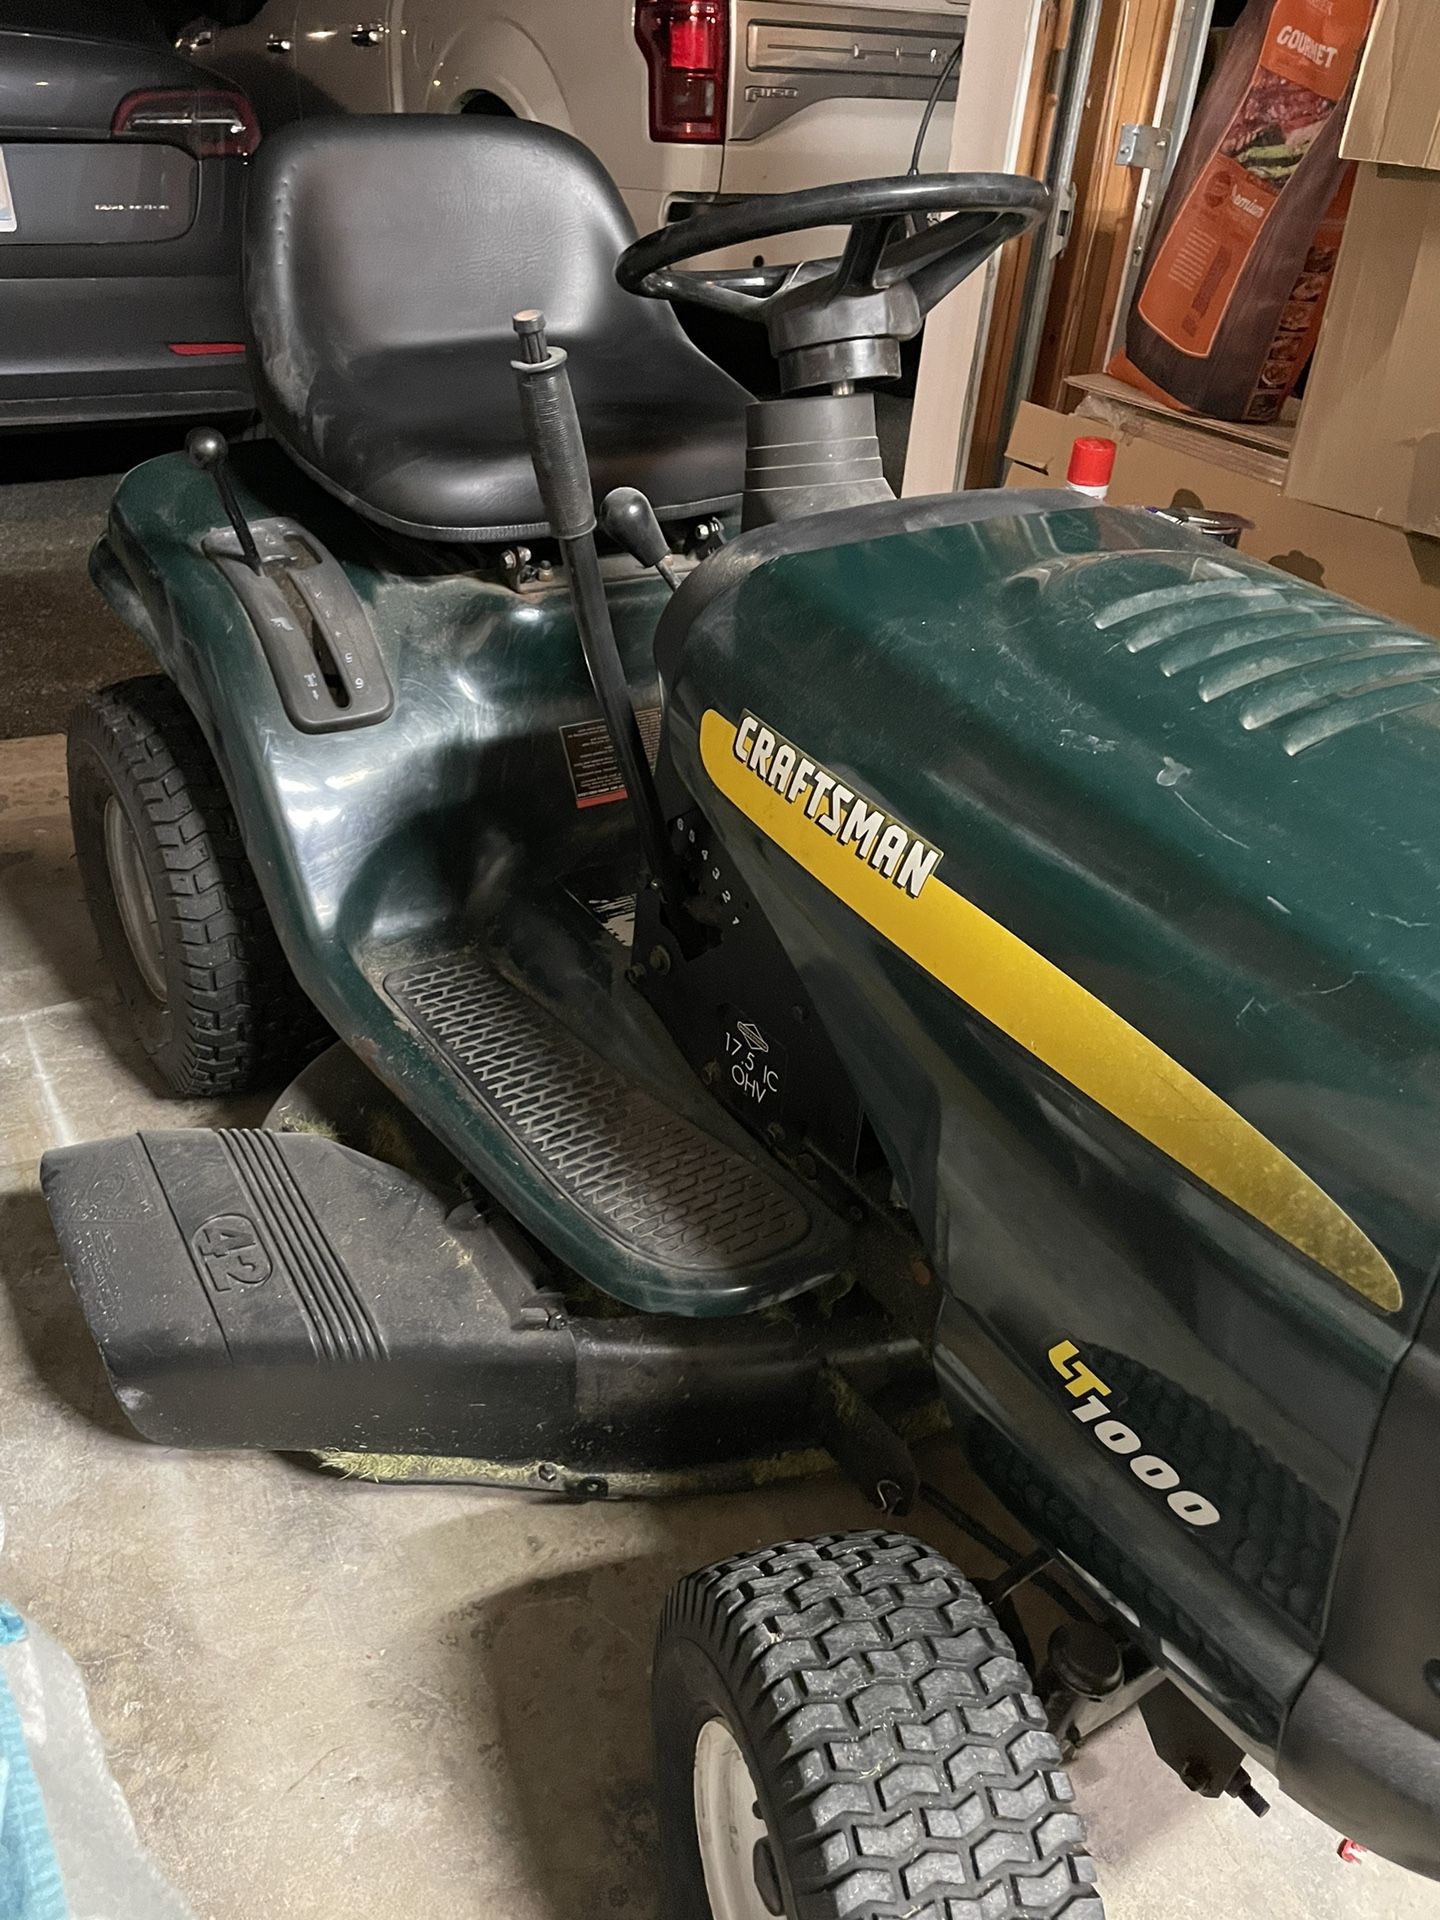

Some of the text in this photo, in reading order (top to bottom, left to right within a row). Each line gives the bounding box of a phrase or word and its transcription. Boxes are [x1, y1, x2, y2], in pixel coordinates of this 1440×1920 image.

[1276, 25, 1338, 68] GOURMET
[733, 716, 940, 899] CRAFTSMAN
[731, 1064, 767, 1103] OHV
[198, 1228, 268, 1293] 42
